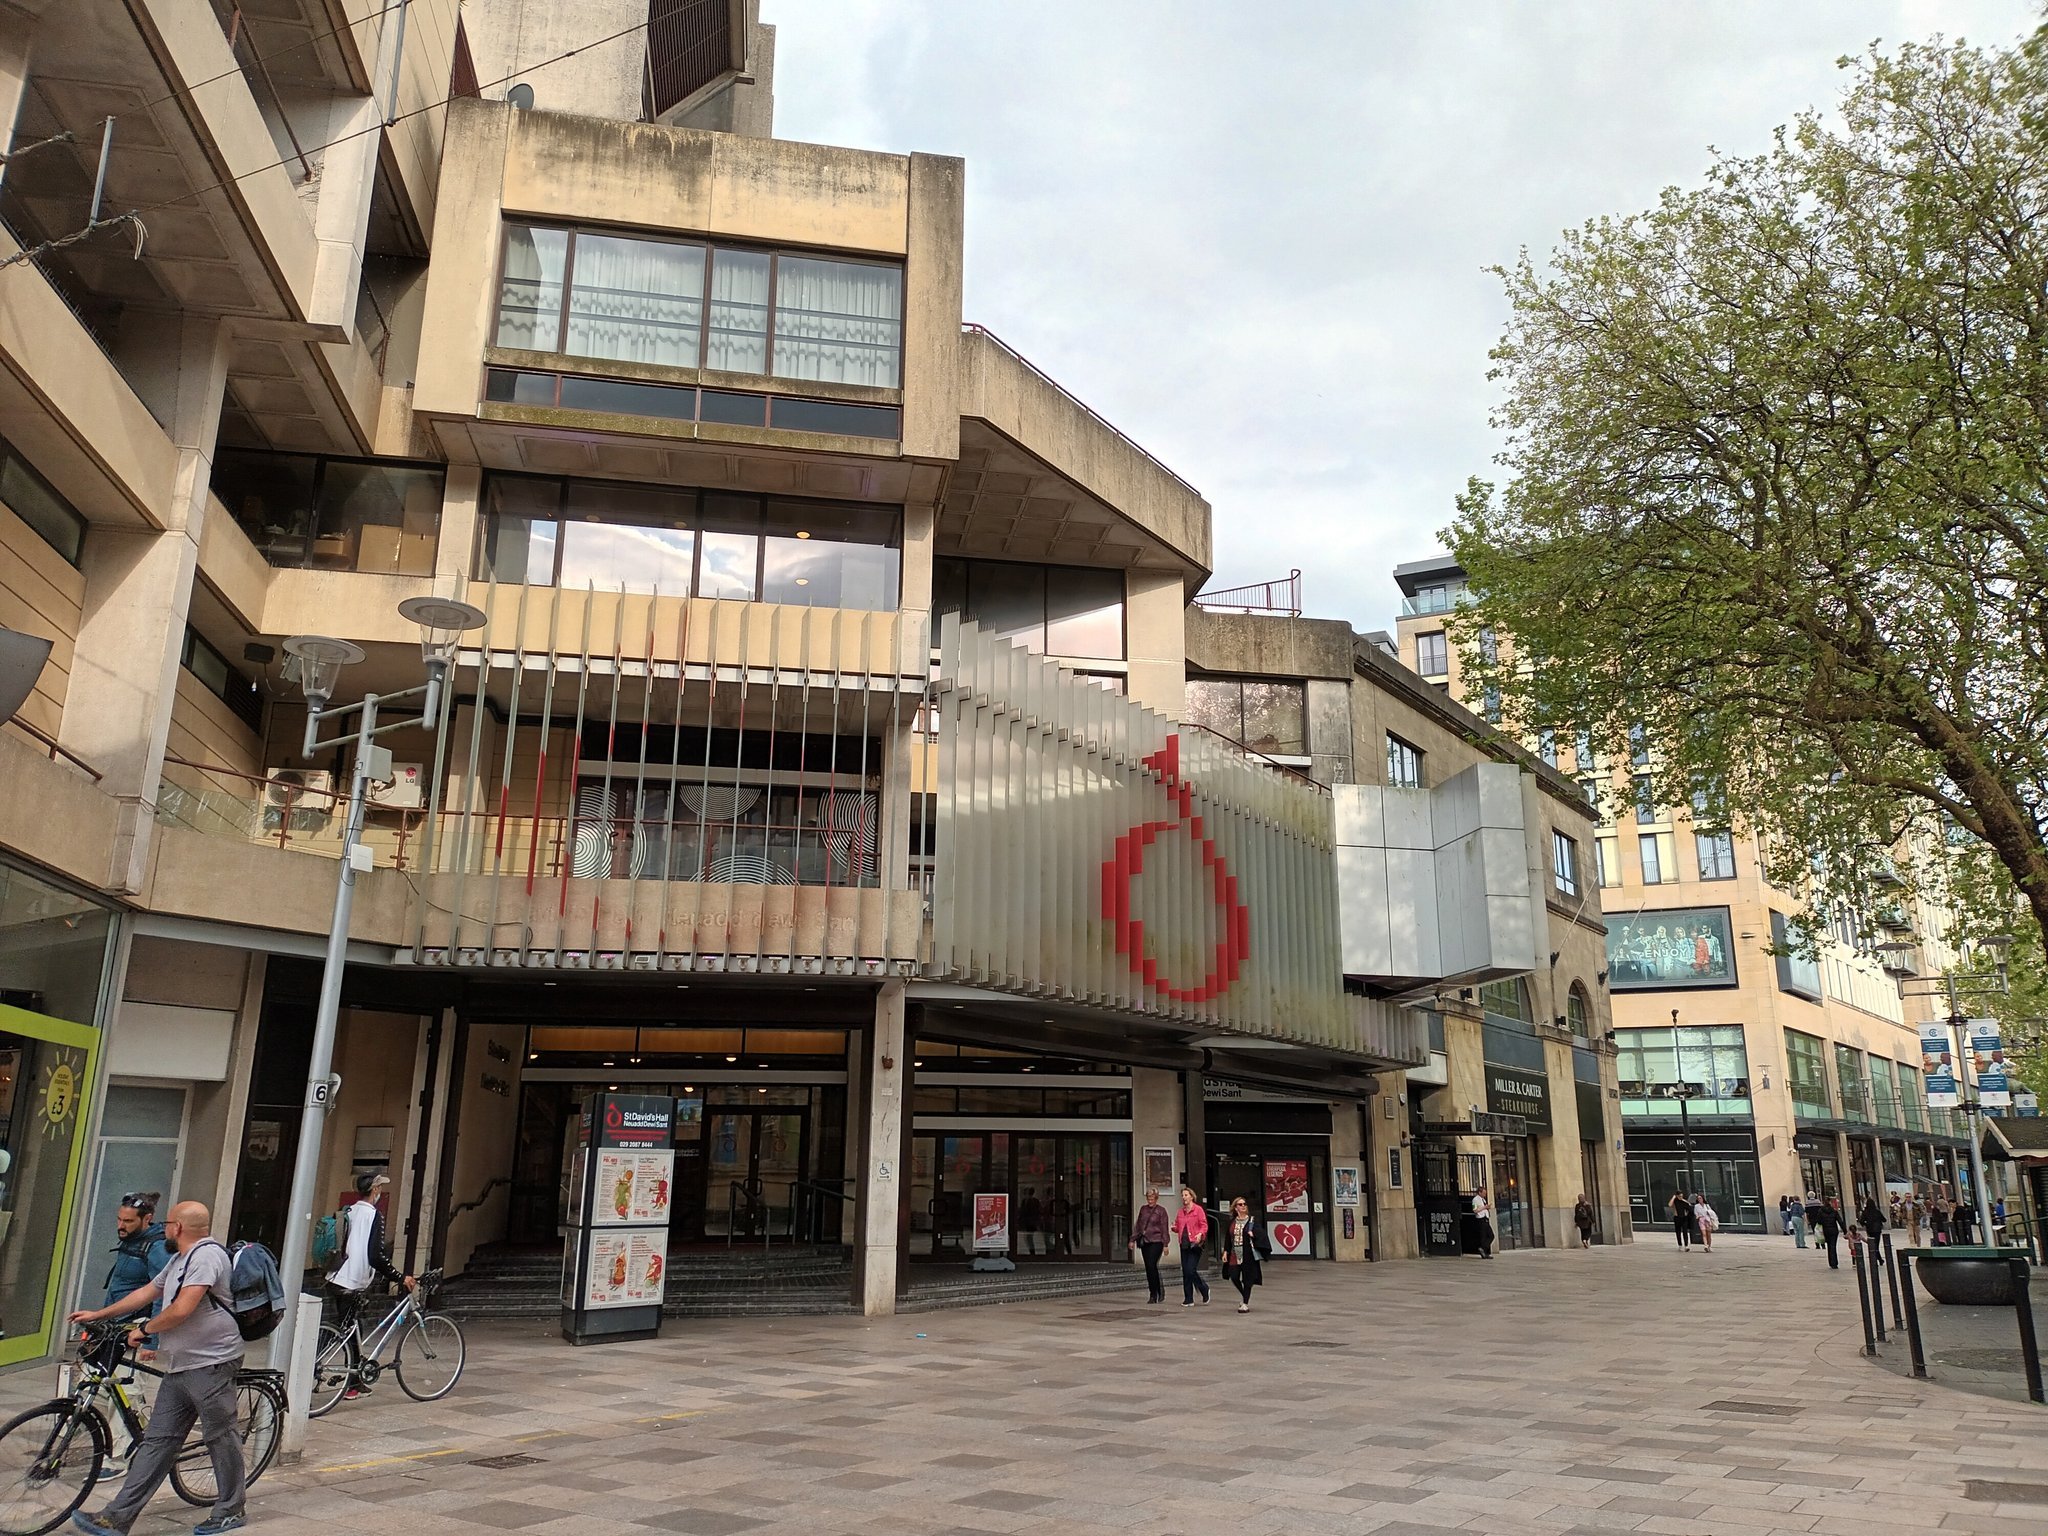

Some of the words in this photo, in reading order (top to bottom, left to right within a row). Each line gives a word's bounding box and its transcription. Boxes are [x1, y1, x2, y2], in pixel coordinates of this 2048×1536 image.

[1645, 948, 1688, 958] ENJOY
[315, 1085, 327, 1101] 6
[1221, 1089, 1242, 1098] Sant
[1495, 1078, 1516, 1094] MILLER
[1516, 1081, 1522, 1095] &
[1521, 1082, 1543, 1098] CARTER
[52, 1095, 65, 1115] £3
[1430, 1212, 1453, 1223] BOWL
[1431, 1222, 1450, 1233] PLAY
